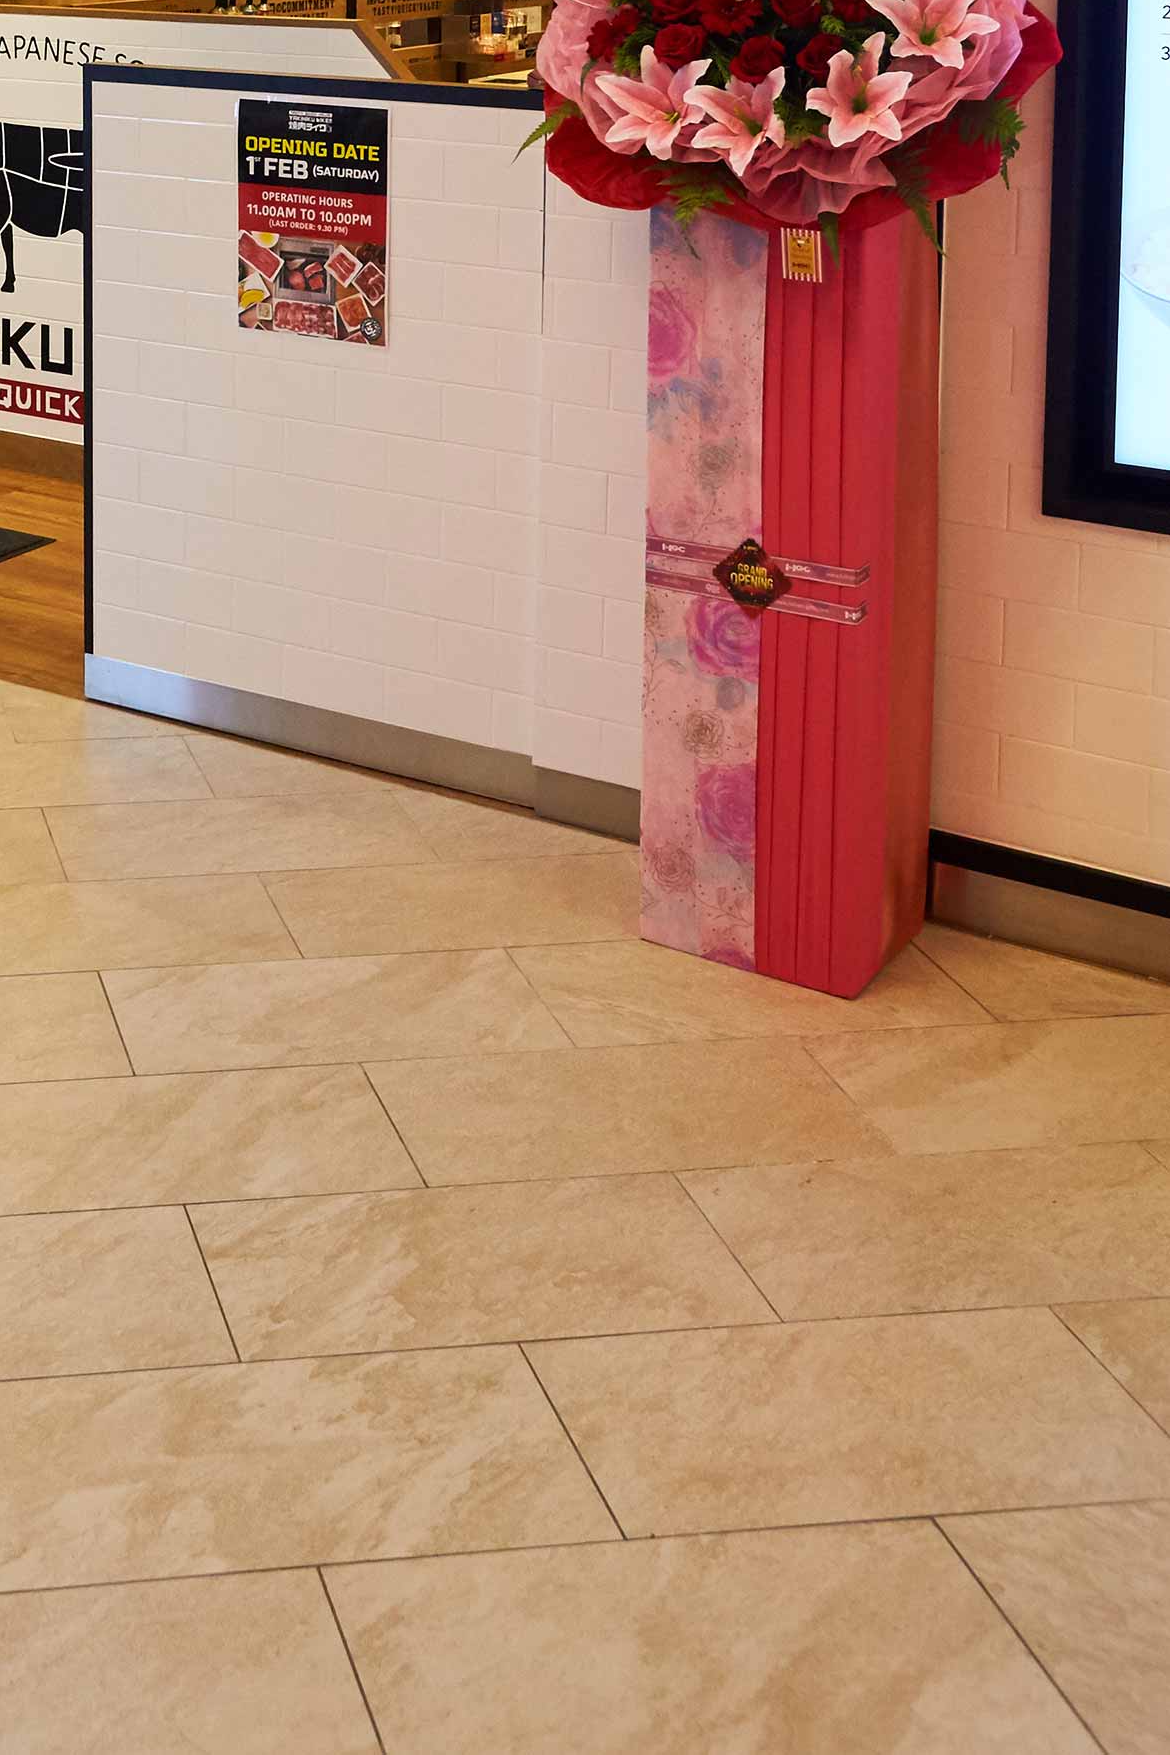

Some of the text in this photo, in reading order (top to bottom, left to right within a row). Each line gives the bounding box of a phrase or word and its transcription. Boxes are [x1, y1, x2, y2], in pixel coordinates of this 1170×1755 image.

[245, 136, 380, 161] OPENING DATE
[264, 157, 308, 180] FEB
[313, 165, 379, 183] (SATURDAY)
[262, 191, 353, 208] OPERATING HOURS
[247, 204, 371, 226] 11.00AM TO 10.00PM
[269, 219, 288, 229] (LAST
[290, 221, 315, 231] ORDER:
[334, 226, 348, 235] PM)
[737, 563, 767, 577] GRAND
[730, 572, 774, 590] OPENING
